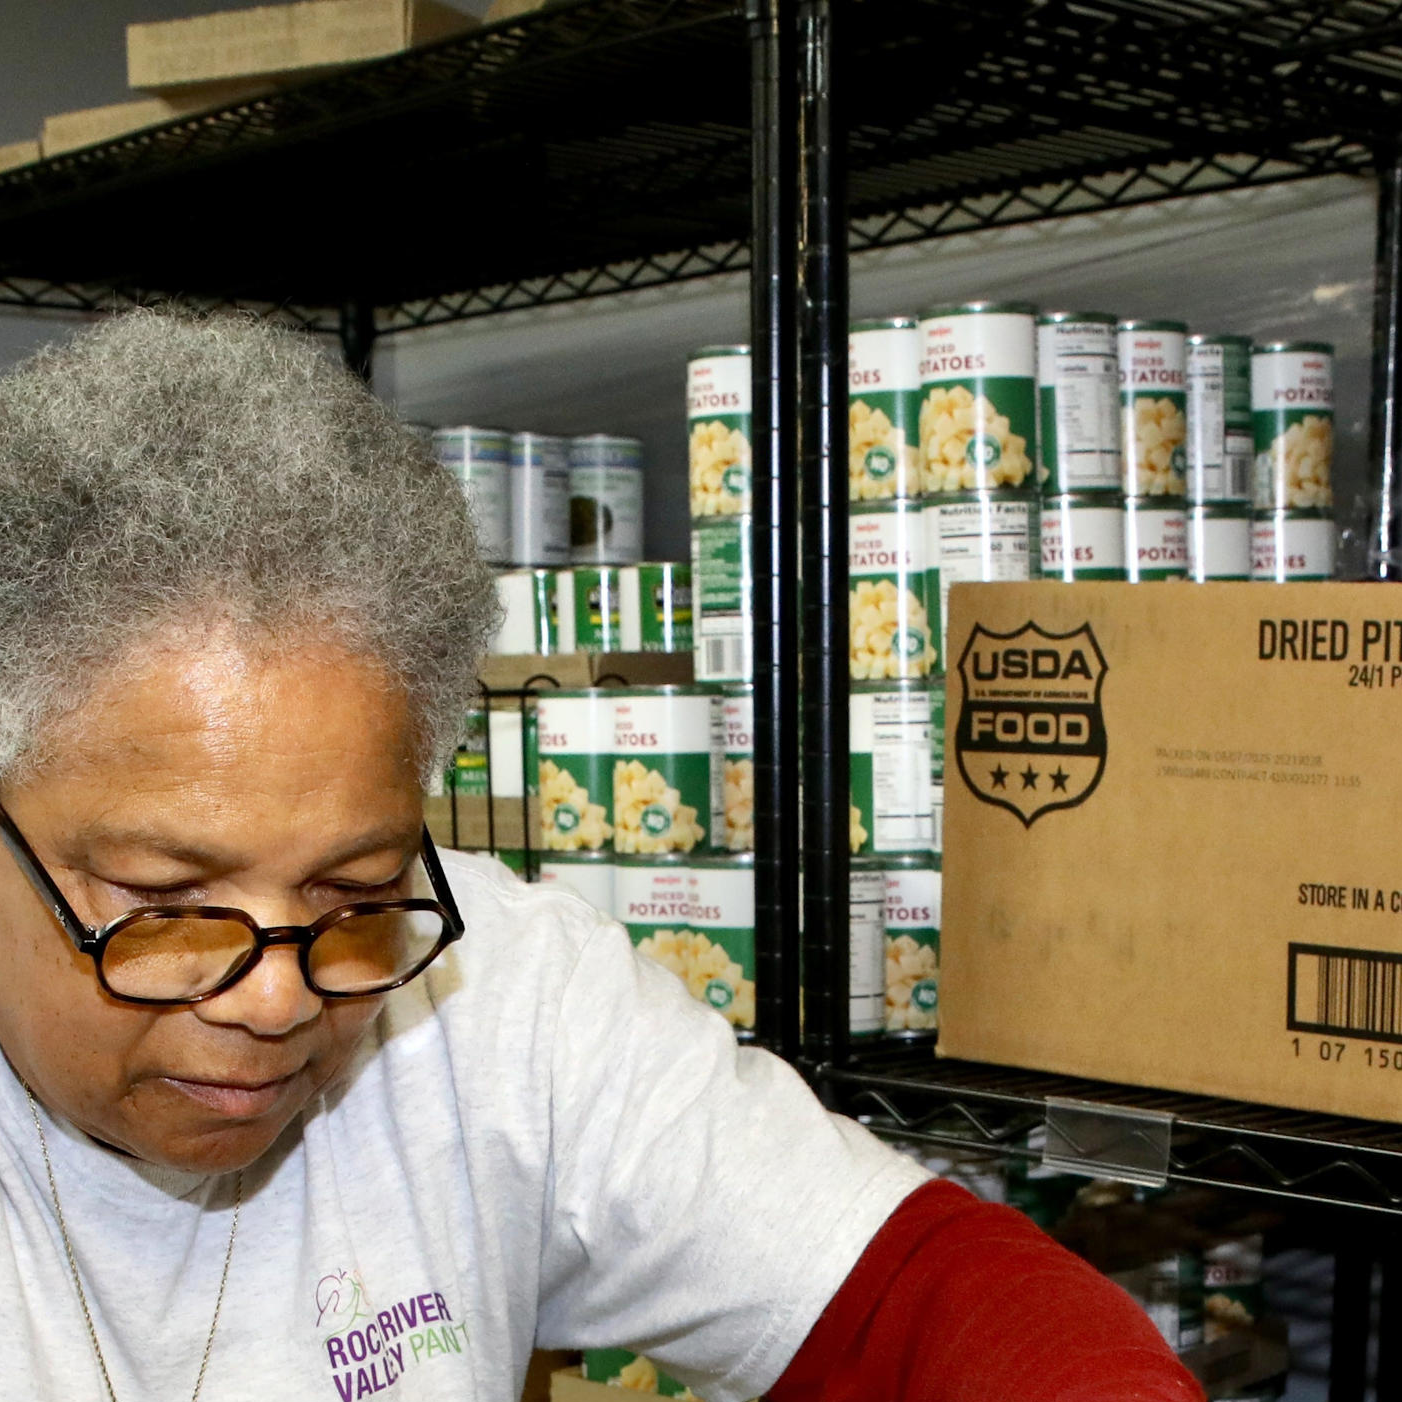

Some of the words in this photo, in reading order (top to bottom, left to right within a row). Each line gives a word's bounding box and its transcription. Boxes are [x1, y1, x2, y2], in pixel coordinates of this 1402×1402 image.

[1258, 619, 1349, 661] DRIED
[972, 648, 1093, 680] USDA
[1348, 664, 1384, 689] 24/1
[970, 710, 1090, 745] FOOD
[1298, 882, 1347, 908] STORE
[1352, 887, 1368, 911] IN
[1373, 889, 1385, 912] A
[1292, 1037, 1300, 1057] 1
[1319, 1040, 1346, 1062] 07
[377, 1291, 453, 1342] RIVER
